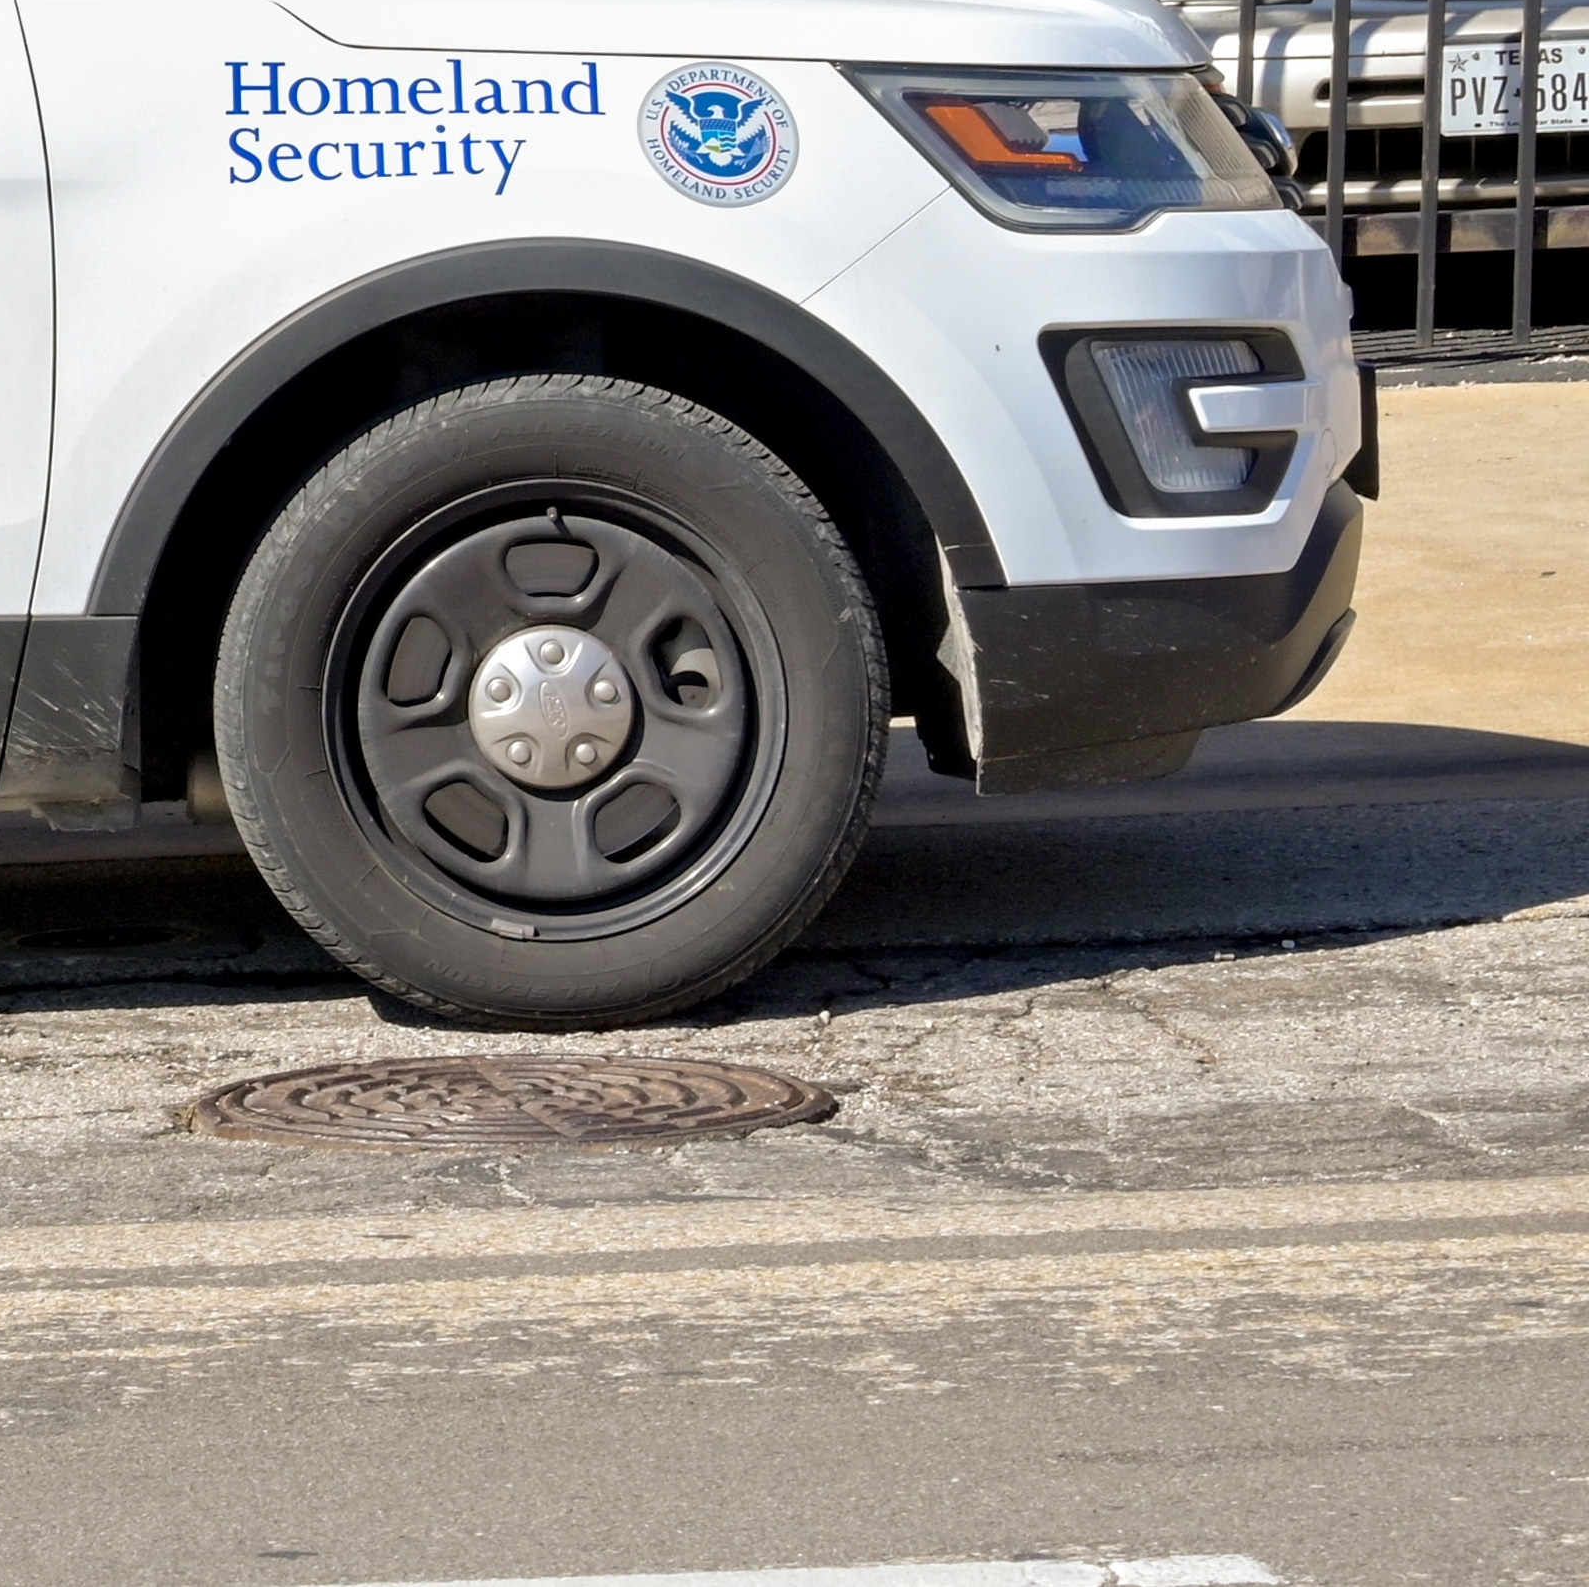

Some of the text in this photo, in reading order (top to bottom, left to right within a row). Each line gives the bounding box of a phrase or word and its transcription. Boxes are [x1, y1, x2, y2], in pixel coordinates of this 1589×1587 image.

[1495, 47, 1563, 66] TEAS
[224, 59, 606, 116] Homeland
[646, 69, 789, 129] U.S. DEPARTMENT OF
[228, 124, 527, 196] Security
[646, 138, 790, 200] HOMELAND SECURITY
